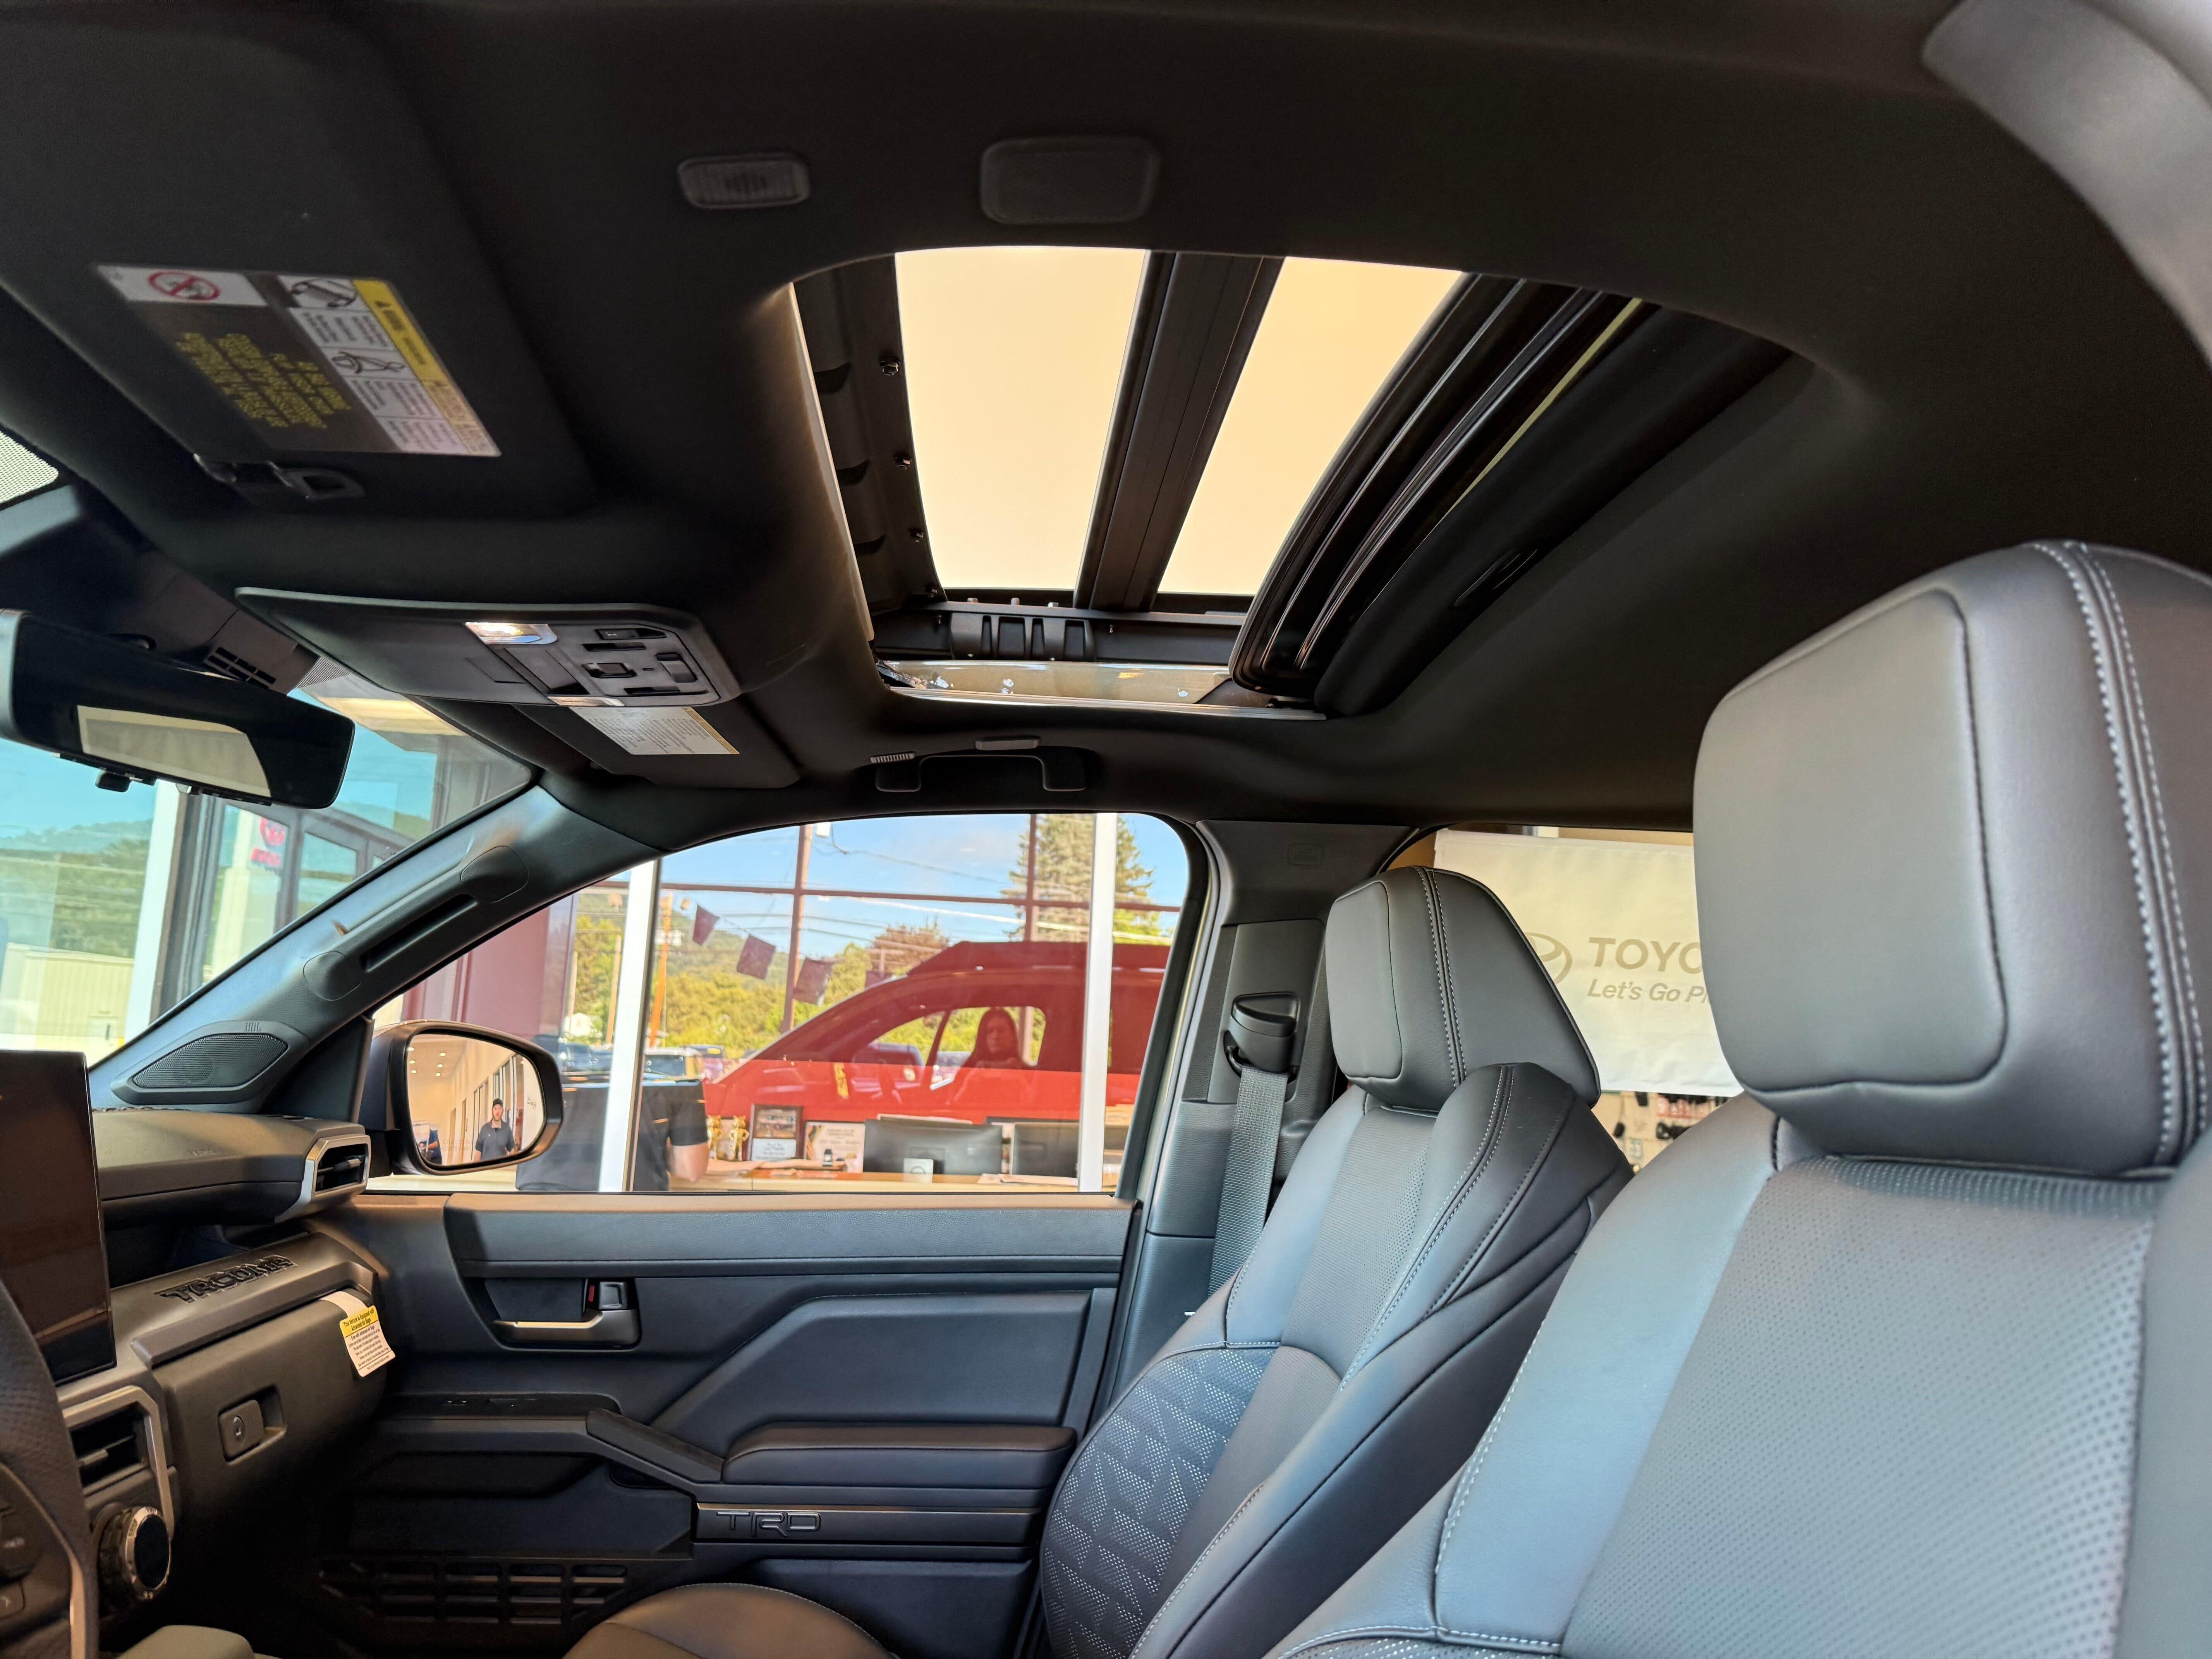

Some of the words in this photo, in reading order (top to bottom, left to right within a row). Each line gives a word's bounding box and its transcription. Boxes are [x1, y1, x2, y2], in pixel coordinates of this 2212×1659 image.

[1589, 937, 1702, 974] TOYO
[1588, 979, 1642, 1000] Let's
[1649, 982, 1681, 1001] Go
[159, 1255, 298, 1304] TACOMA
[716, 1511, 821, 1537] TRD
